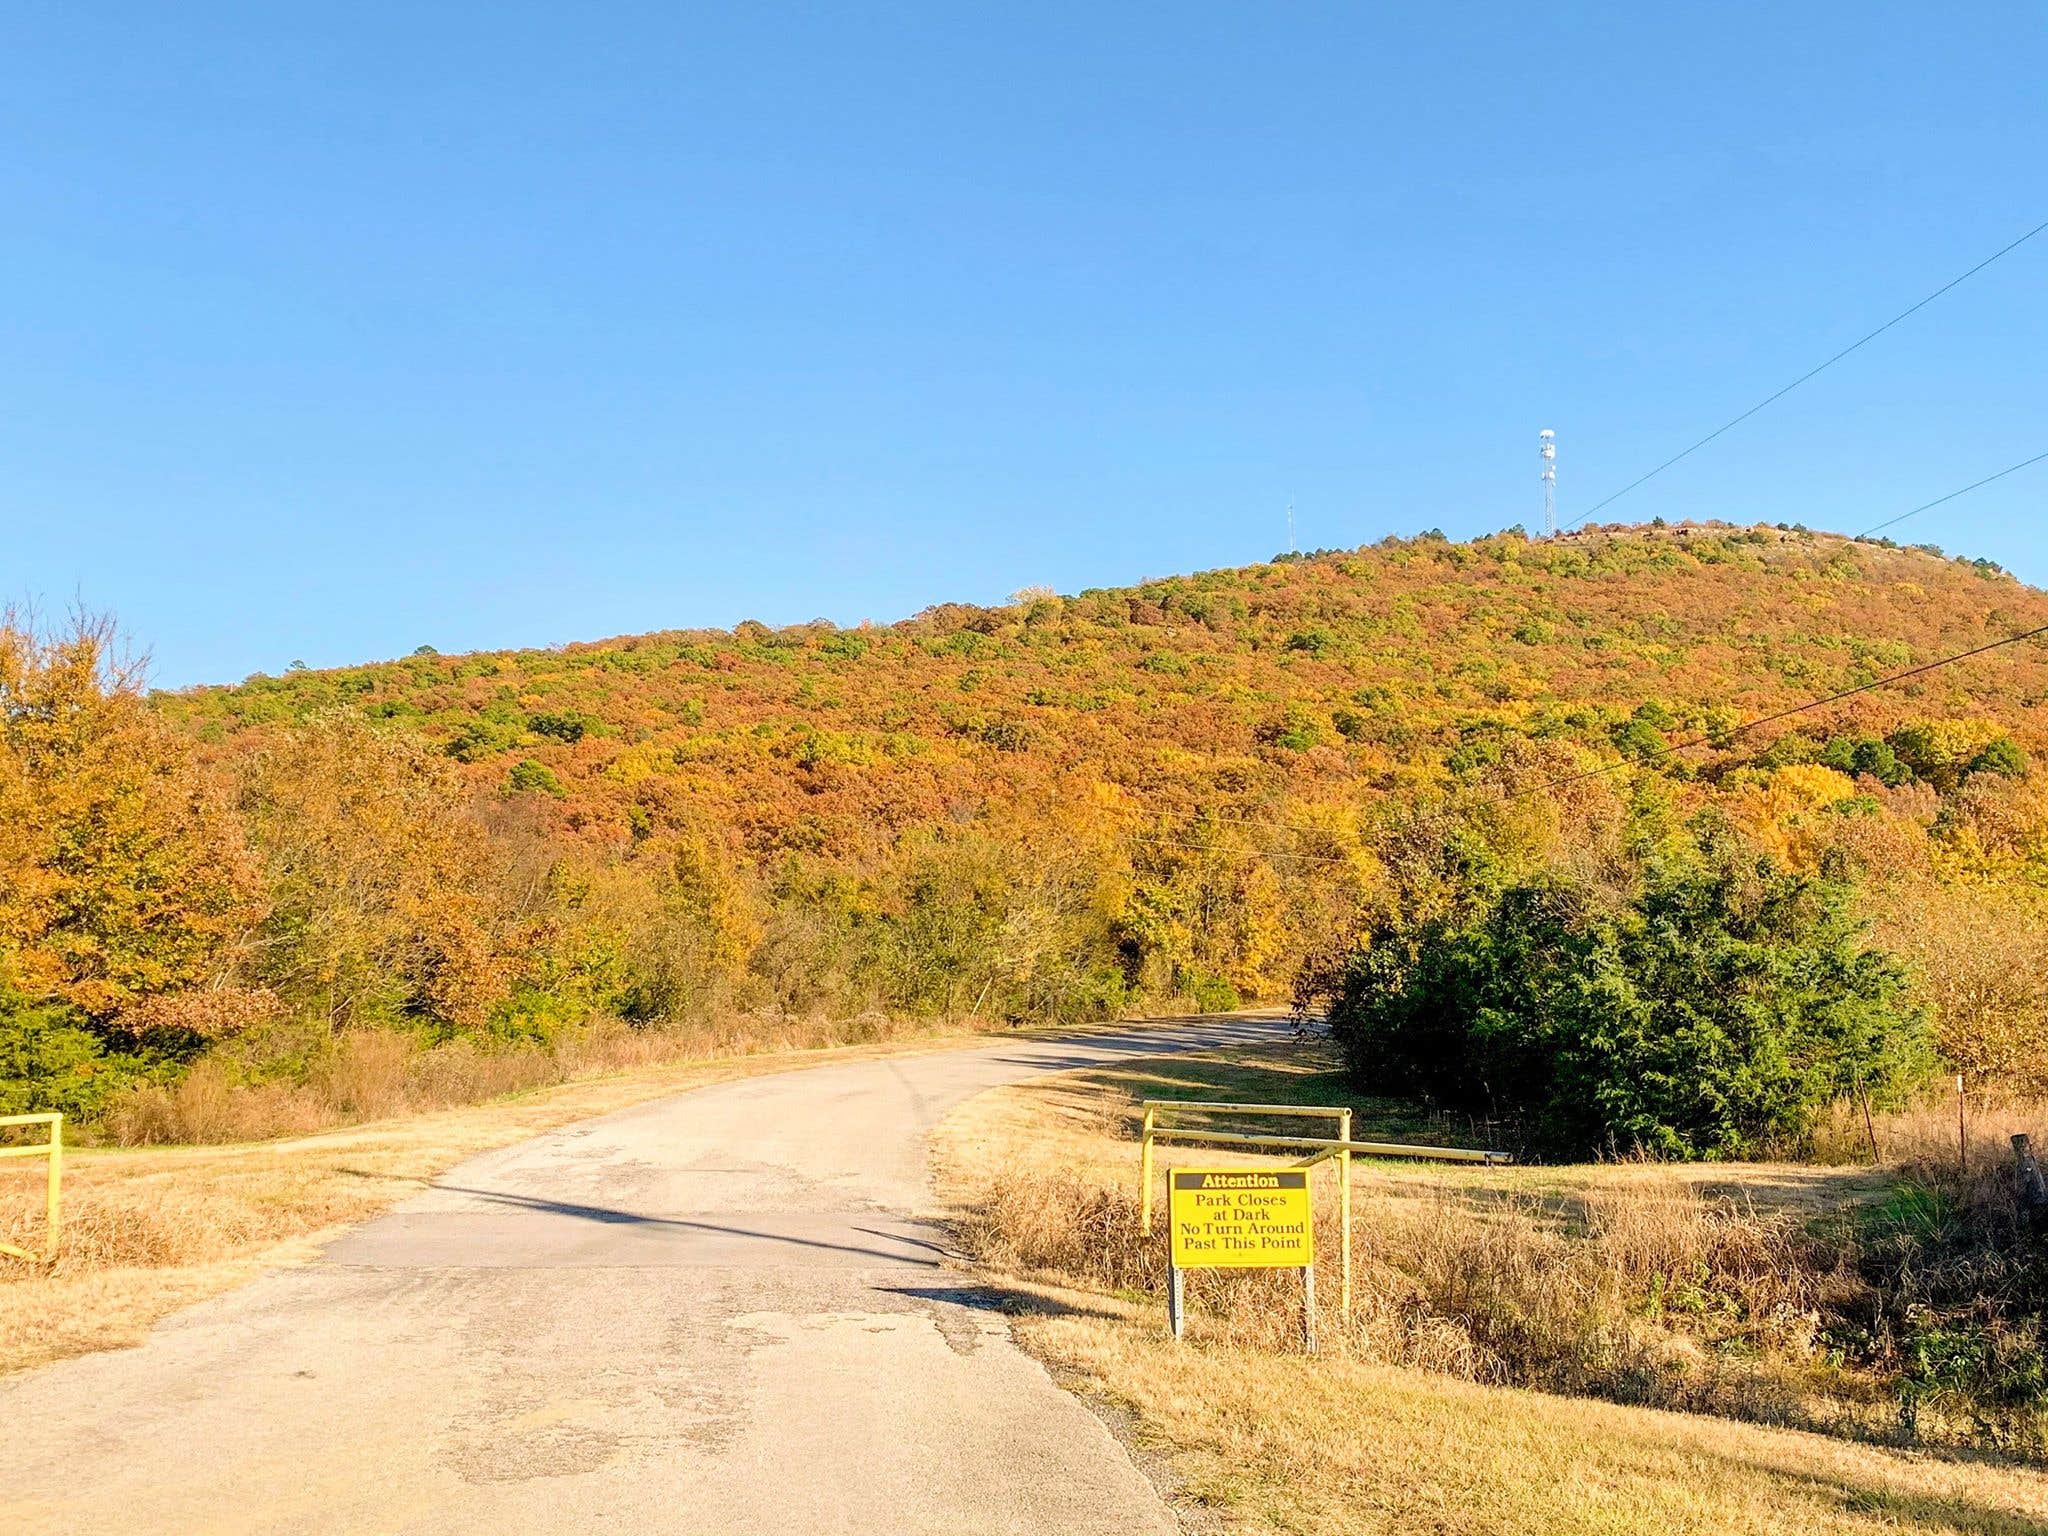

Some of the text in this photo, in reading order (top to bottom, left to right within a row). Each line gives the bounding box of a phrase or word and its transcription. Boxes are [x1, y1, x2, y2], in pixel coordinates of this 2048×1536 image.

[1202, 1174, 1279, 1188] Attention
[1196, 1193, 1286, 1206] Park Closes
[1213, 1209, 1270, 1221] at Dark
[1181, 1222, 1304, 1235] No Turn Around
[1185, 1237, 1302, 1250] Past This Point
